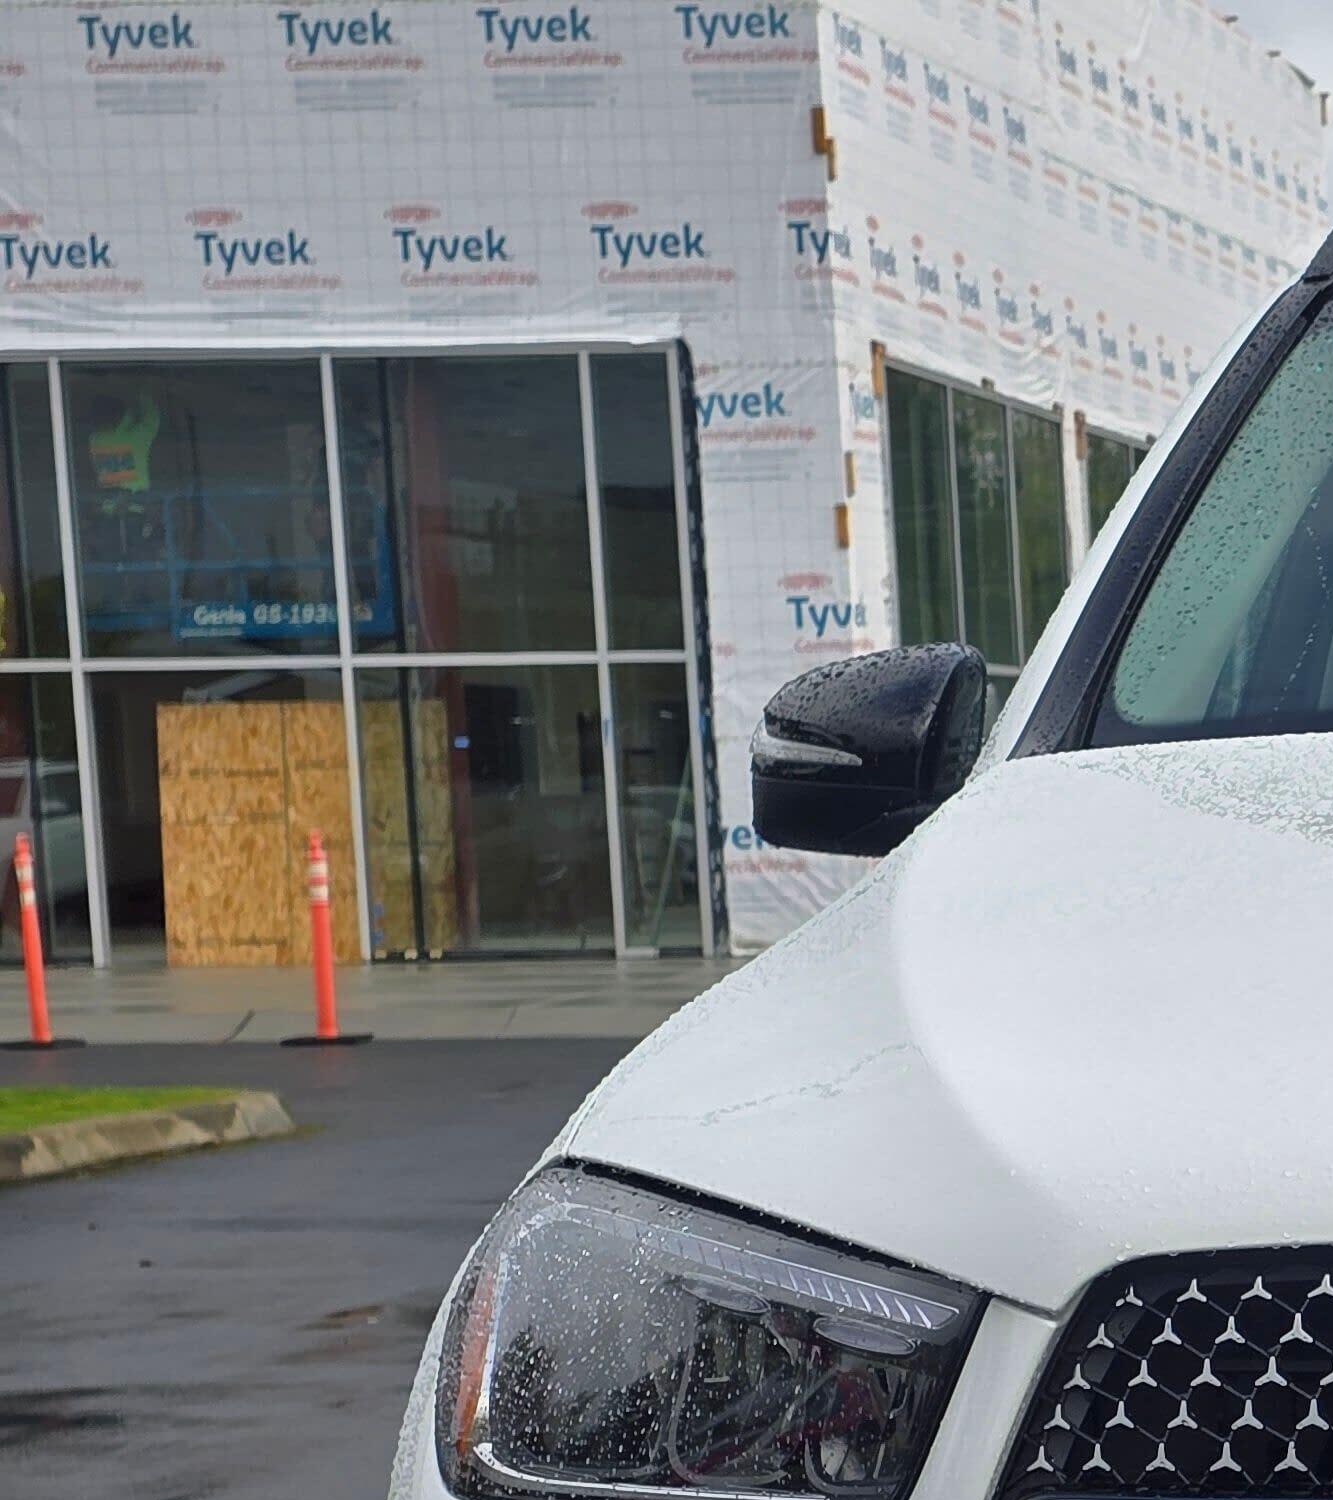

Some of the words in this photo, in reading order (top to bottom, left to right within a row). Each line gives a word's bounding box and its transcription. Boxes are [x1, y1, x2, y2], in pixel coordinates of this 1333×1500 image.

[77, 10, 194, 58] Tyvek
[278, 9, 393, 55] Tyvek
[476, 6, 592, 52] Tyvek
[675, 4, 790, 48] Tyvek
[0, 232, 111, 279] Tyvek
[194, 228, 310, 275] Tyvek
[392, 226, 508, 271] Tyvek
[590, 222, 705, 268] Tyvek
